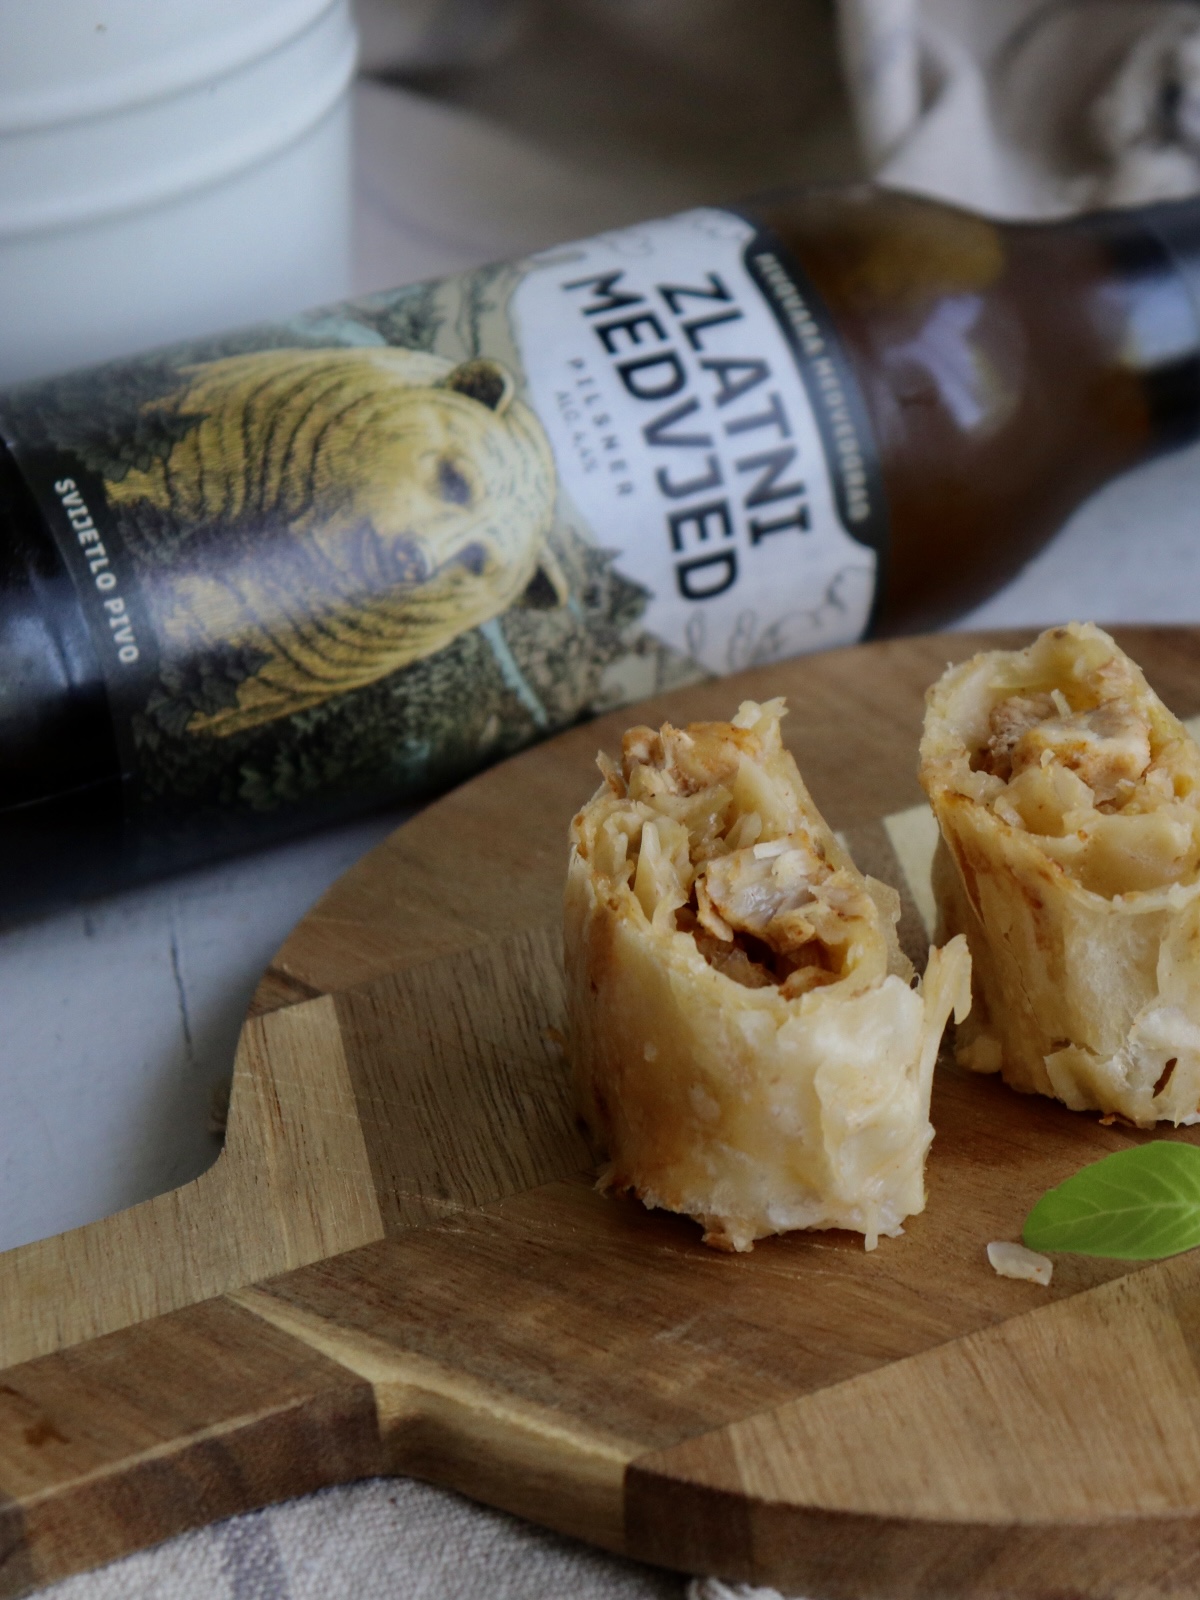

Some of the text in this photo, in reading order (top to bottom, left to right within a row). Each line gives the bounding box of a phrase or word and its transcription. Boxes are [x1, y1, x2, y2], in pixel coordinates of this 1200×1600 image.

[561, 270, 738, 600] MEDVJED
[567, 358, 634, 496] PILSNER
[655, 270, 813, 547] ZLATNI
[54, 477, 140, 665] SVIJETLO PIVO
